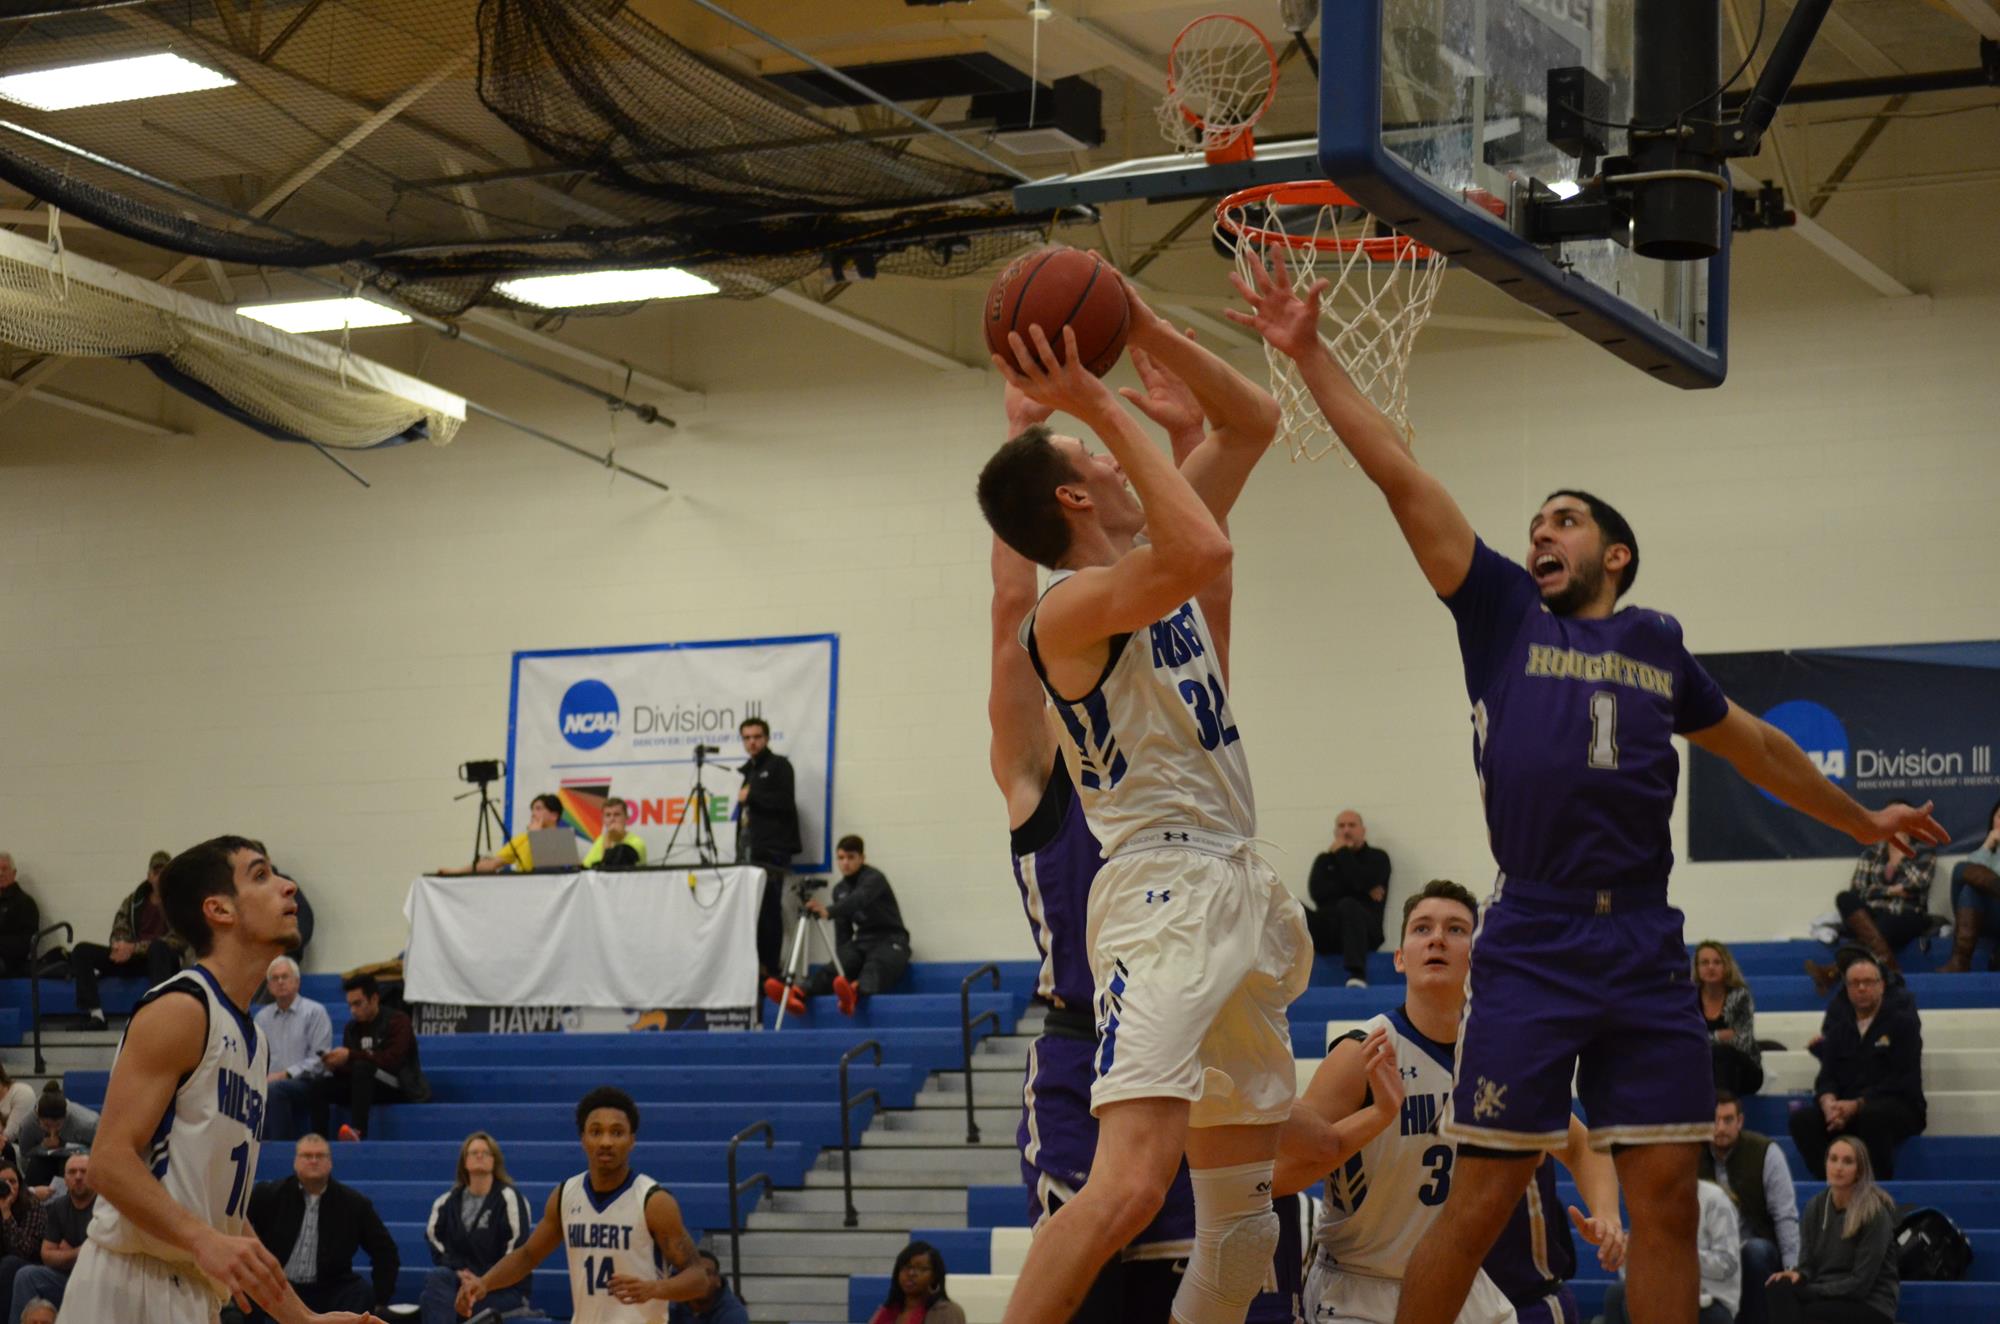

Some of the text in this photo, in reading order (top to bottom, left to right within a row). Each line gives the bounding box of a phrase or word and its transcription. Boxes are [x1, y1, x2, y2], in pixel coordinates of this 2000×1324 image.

[1525, 643, 1673, 699] HOUGHTON
[563, 711, 620, 736] NCAA
[633, 700, 735, 735] Division
[1588, 690, 1618, 770] 1
[1857, 745, 1990, 778] Division III
[1857, 777, 1905, 789] DISCOVER
[1911, 775, 1959, 788] DEVELOP
[421, 1021, 456, 1036] DECK
[422, 1006, 467, 1019] MEDIA
[1418, 1144, 1453, 1206] 3
[568, 1223, 633, 1250] HILBERT
[584, 1255, 615, 1296] 14
